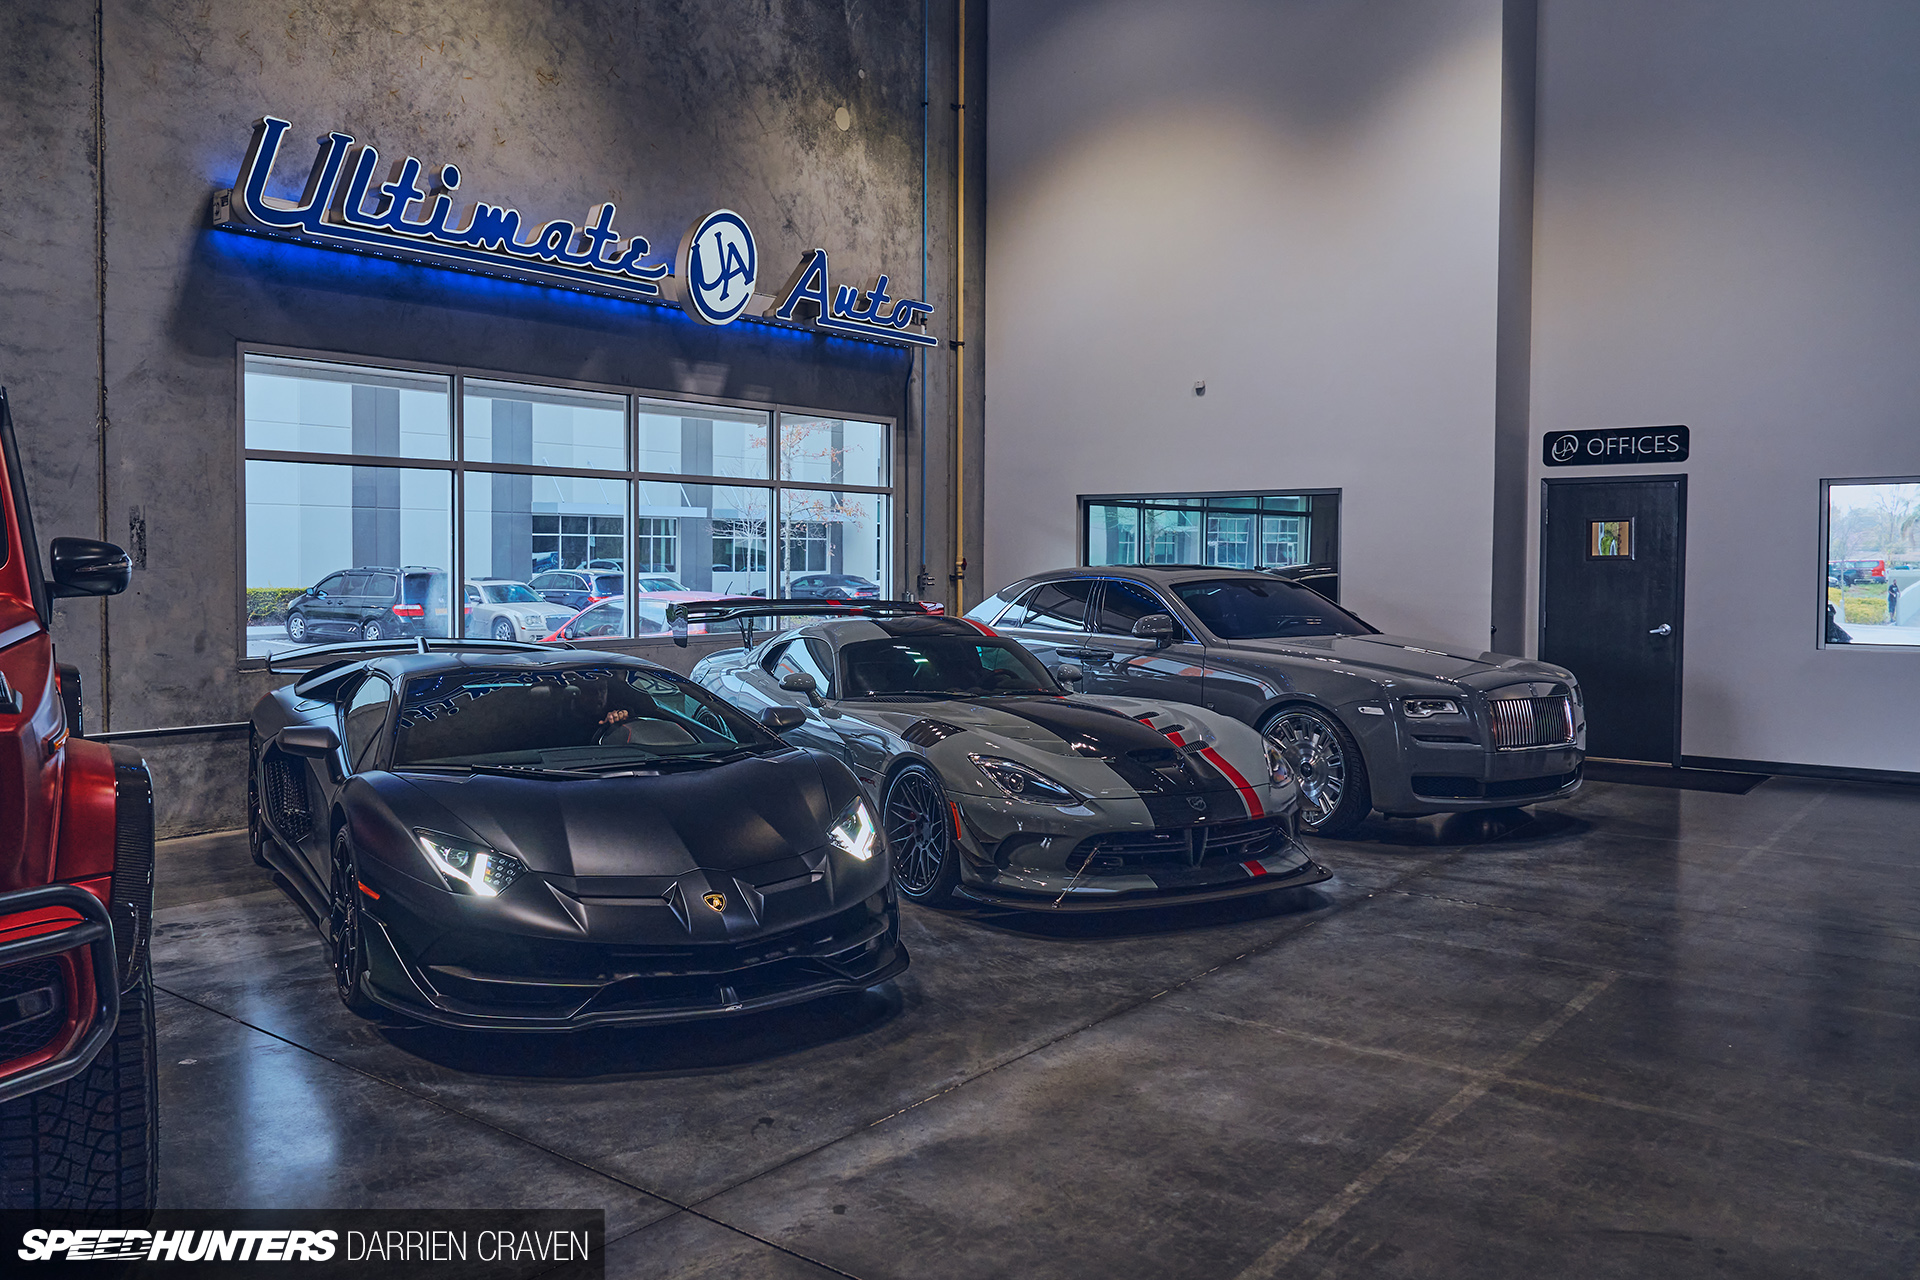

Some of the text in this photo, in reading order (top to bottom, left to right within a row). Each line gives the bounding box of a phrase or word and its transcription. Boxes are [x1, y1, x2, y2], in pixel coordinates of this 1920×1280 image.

[244, 115, 669, 290] Ultimate
[776, 248, 936, 342] Auto
[1587, 434, 1680, 456] OFFICES
